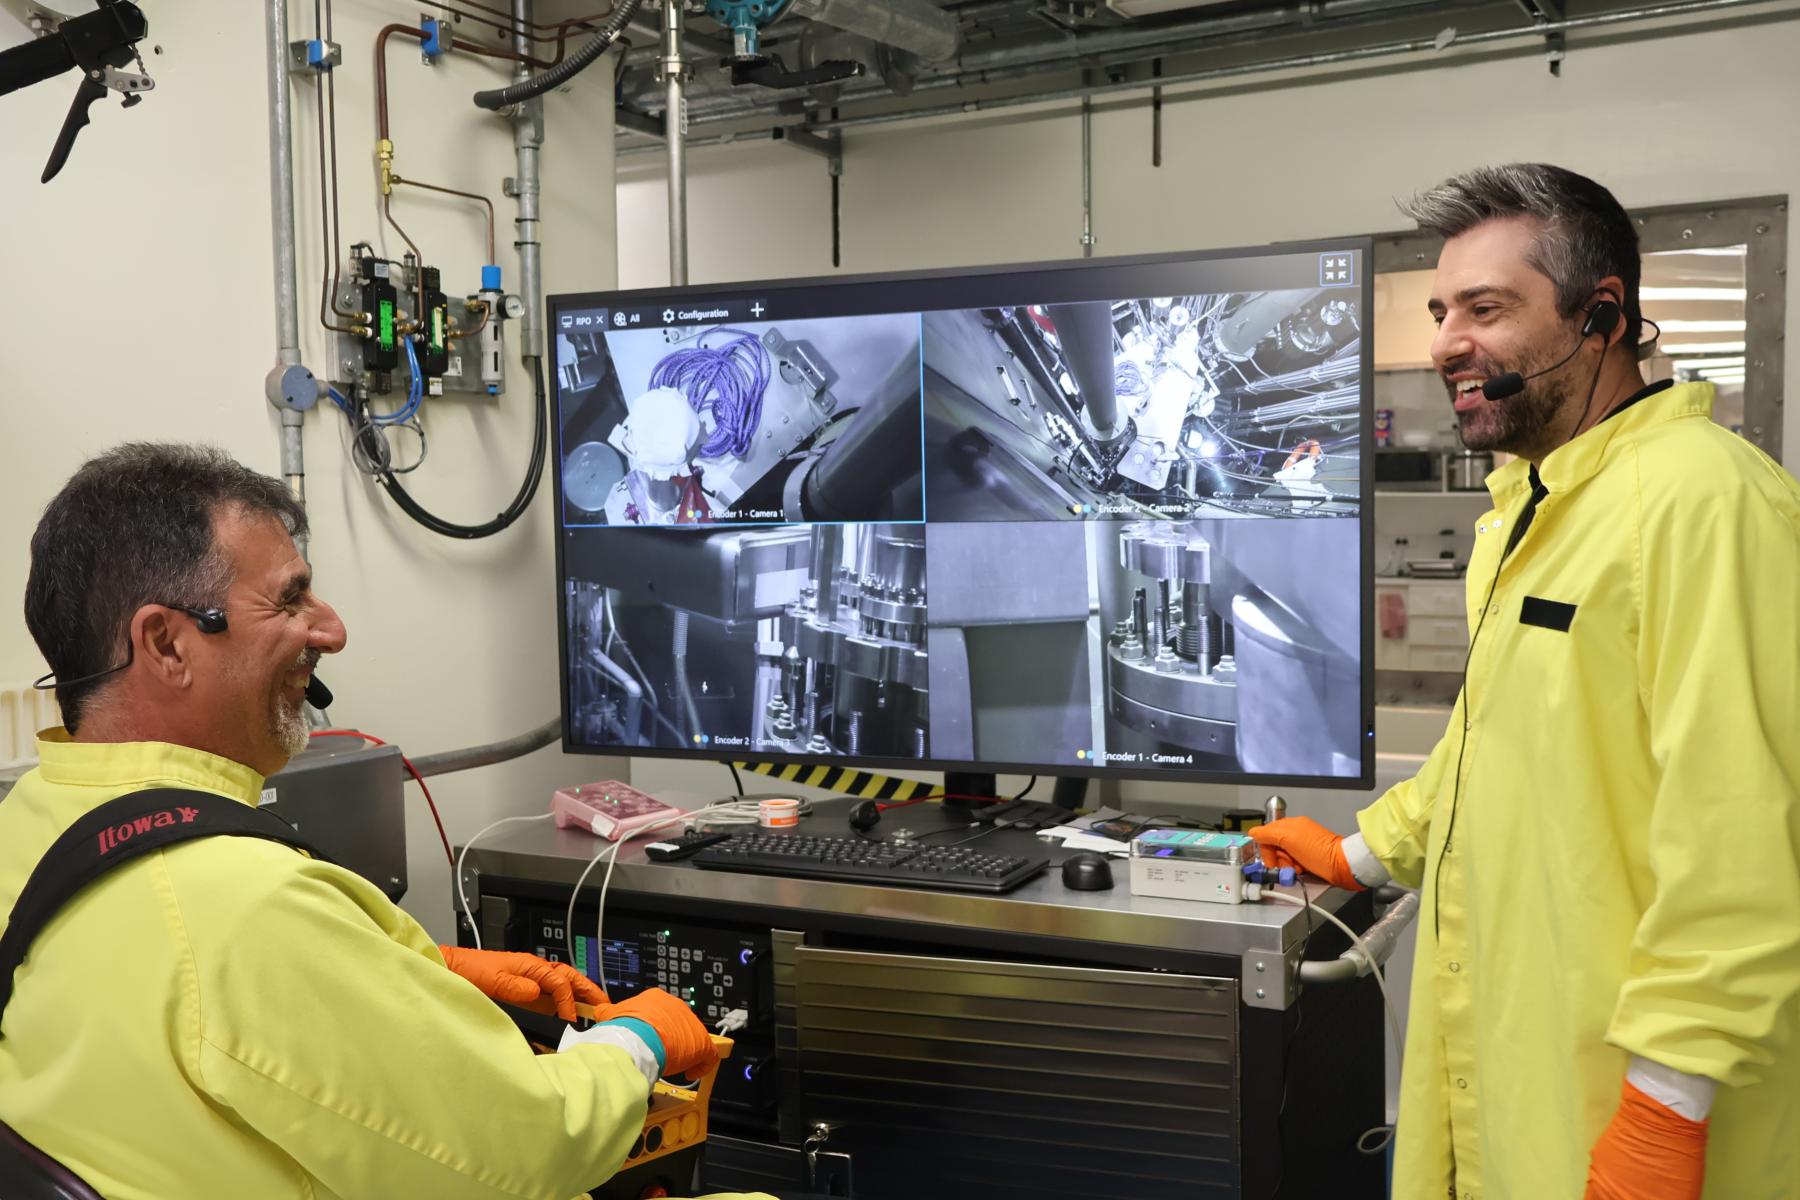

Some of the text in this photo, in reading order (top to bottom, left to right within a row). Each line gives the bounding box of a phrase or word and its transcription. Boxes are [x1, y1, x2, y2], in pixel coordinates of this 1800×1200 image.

[630, 314, 640, 323] All
[678, 309, 729, 321] Configuration
[575, 317, 592, 326] RPO
[1098, 504, 1132, 513] Encoder
[1148, 503, 1181, 513] Camera
[708, 510, 737, 519] Encoder
[749, 509, 778, 519] Camera
[714, 735, 743, 745] Encoder
[756, 737, 784, 747] Camera
[1102, 751, 1136, 761] Encoder
[1151, 753, 1185, 763] Camera
[1186, 754, 1193, 764] 4
